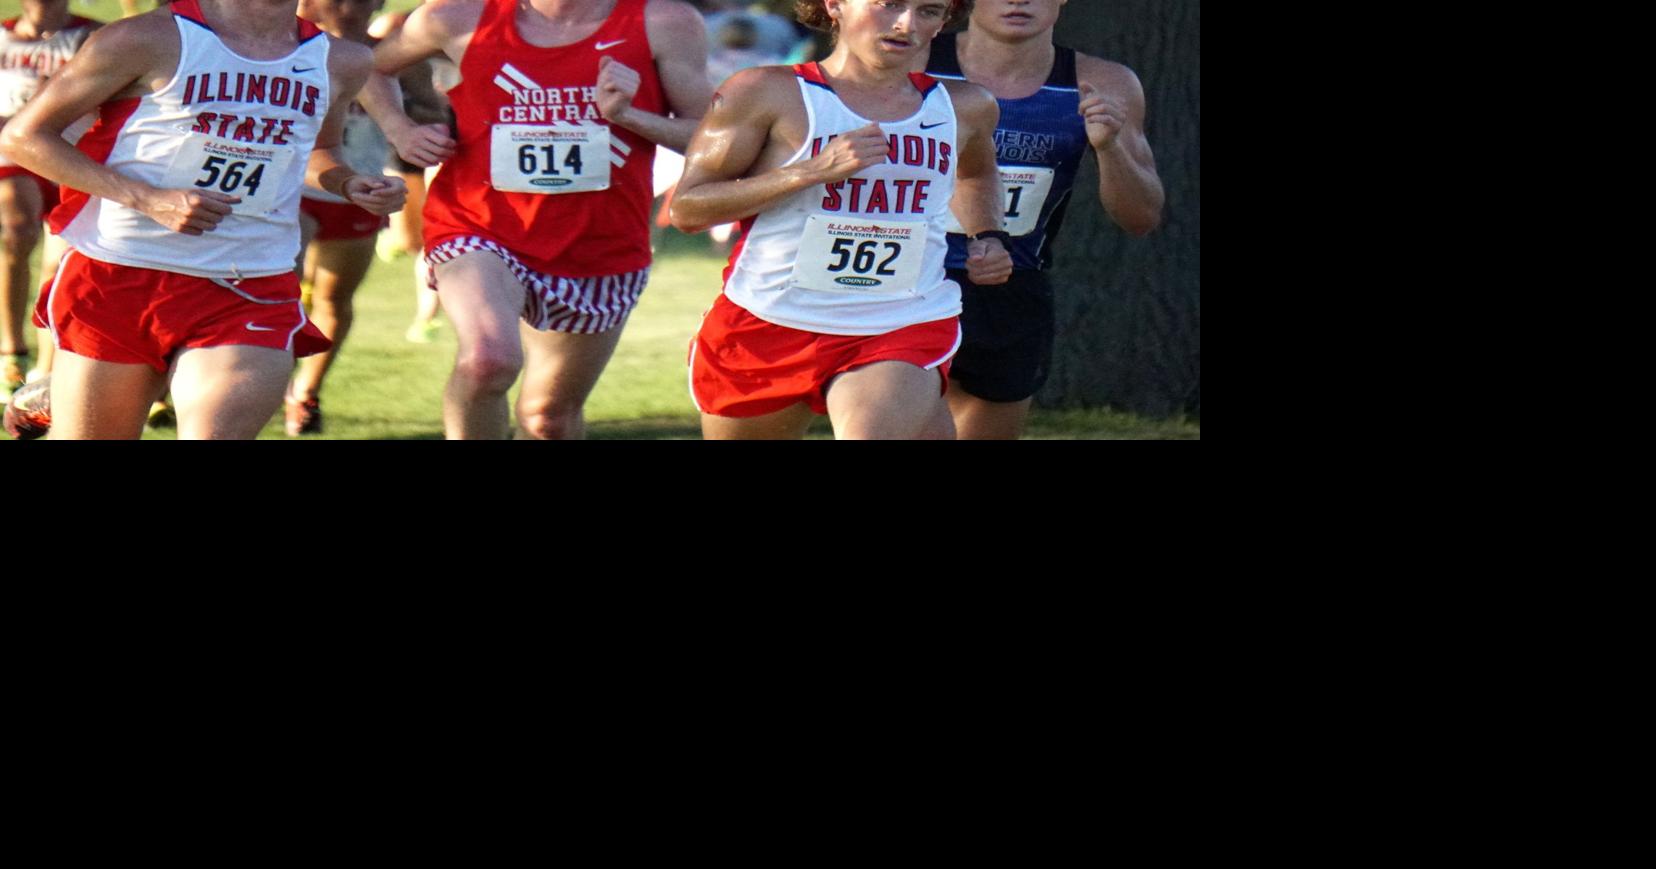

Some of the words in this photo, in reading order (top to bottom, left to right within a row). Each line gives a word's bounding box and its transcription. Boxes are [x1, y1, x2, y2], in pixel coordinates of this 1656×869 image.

[182, 72, 320, 117] ILLINOIS
[513, 86, 597, 105] NORTH
[191, 112, 295, 145] STATE
[500, 104, 602, 122] CENTRA
[992, 128, 1055, 150] TERN
[518, 144, 582, 175] 614
[194, 155, 265, 196] 564
[822, 178, 931, 213] STATE
[881, 227, 912, 235] STATE
[827, 238, 902, 276] 562
[839, 277, 876, 285] COUNTRY
